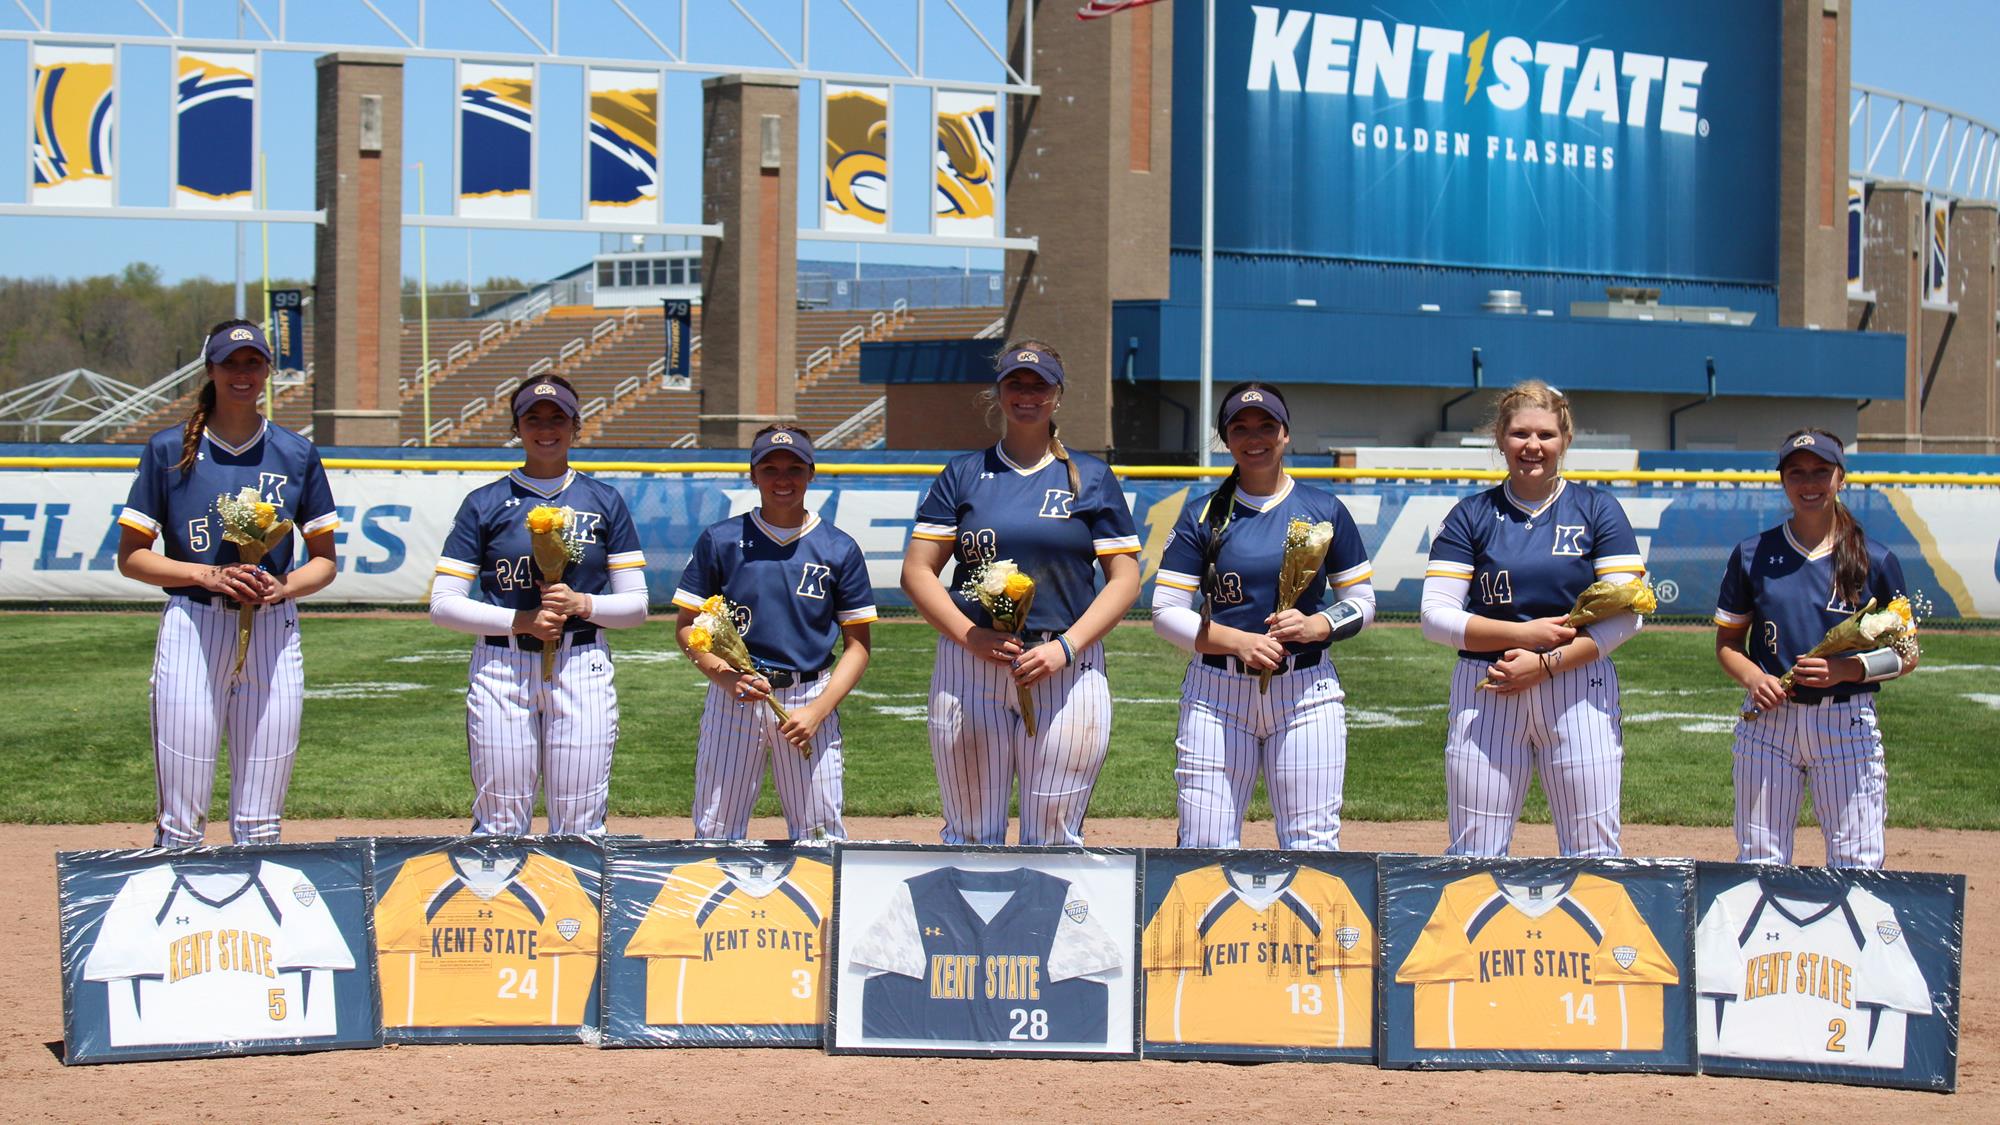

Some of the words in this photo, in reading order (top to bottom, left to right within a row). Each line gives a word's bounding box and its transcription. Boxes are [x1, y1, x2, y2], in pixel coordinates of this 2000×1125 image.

[1247, 5, 1465, 102] KENT
[1486, 36, 1708, 136] STATE
[1352, 122, 1470, 157] GOLDEN
[1486, 135, 1615, 170] FLASHES
[275, 292, 299, 307] 99
[667, 302, 688, 316] 79
[278, 309, 290, 356] LAMBERT
[259, 472, 288, 507] K
[1039, 488, 1075, 518] K
[188, 517, 211, 553] 5
[572, 511, 601, 544] K
[1552, 525, 1585, 556] K
[961, 528, 997, 564] 28
[496, 556, 532, 591] 24
[796, 562, 831, 599] K
[1210, 572, 1243, 604] 13
[1480, 570, 1512, 605] 14
[734, 605, 751, 637] 3
[1763, 620, 1777, 655] 2
[169, 930, 213, 984] KENT
[218, 929, 275, 979] STATE
[432, 927, 476, 957] KENT
[483, 927, 537, 960] STATE
[703, 928, 749, 962] KENT
[756, 928, 814, 962] STATE
[1202, 942, 1250, 976] KENT
[1257, 941, 1317, 975] STATE
[497, 967, 538, 999] 24
[791, 969, 812, 999] 3
[930, 954, 980, 1000] KENT
[985, 955, 1040, 1000] STATE
[1479, 948, 1526, 983] KENT
[1533, 949, 1592, 985] STATE
[1744, 951, 1792, 1001] KENT
[1796, 951, 1852, 1010] STATE
[268, 988, 287, 1021] 5
[1285, 983, 1322, 1015] 13
[1560, 991, 1596, 1025] 14
[1009, 1008, 1049, 1040] 28
[1826, 1018, 1847, 1053] 2
